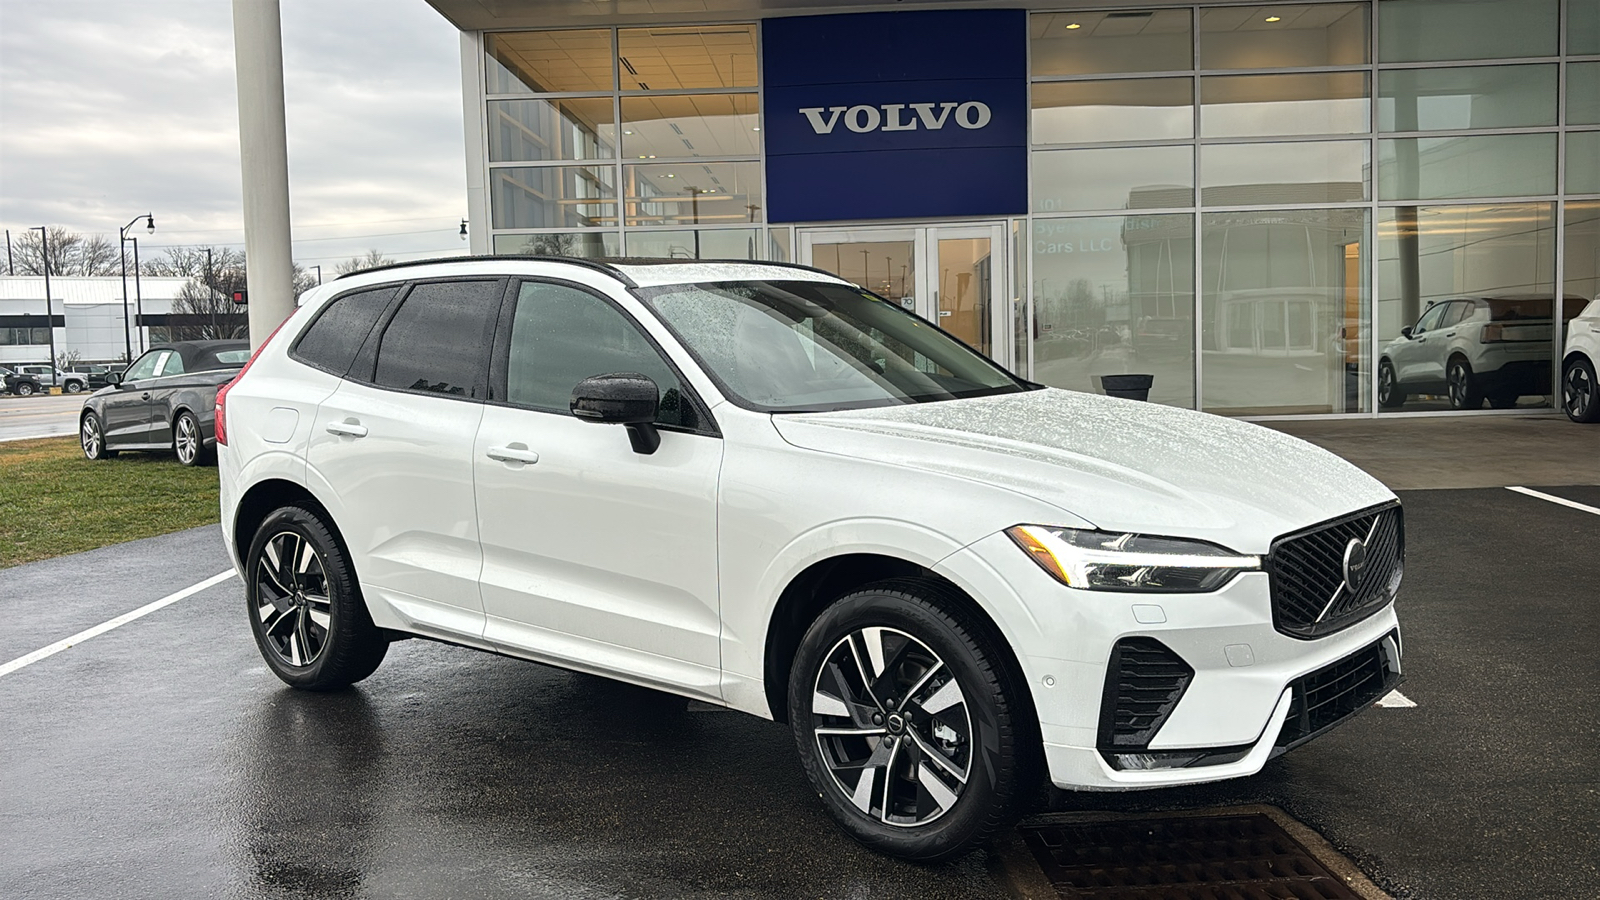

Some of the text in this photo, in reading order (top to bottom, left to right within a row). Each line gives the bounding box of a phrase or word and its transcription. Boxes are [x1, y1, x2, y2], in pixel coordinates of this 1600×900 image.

[799, 101, 991, 134] VOLVO
[1035, 238, 1112, 254] Cars LLC
